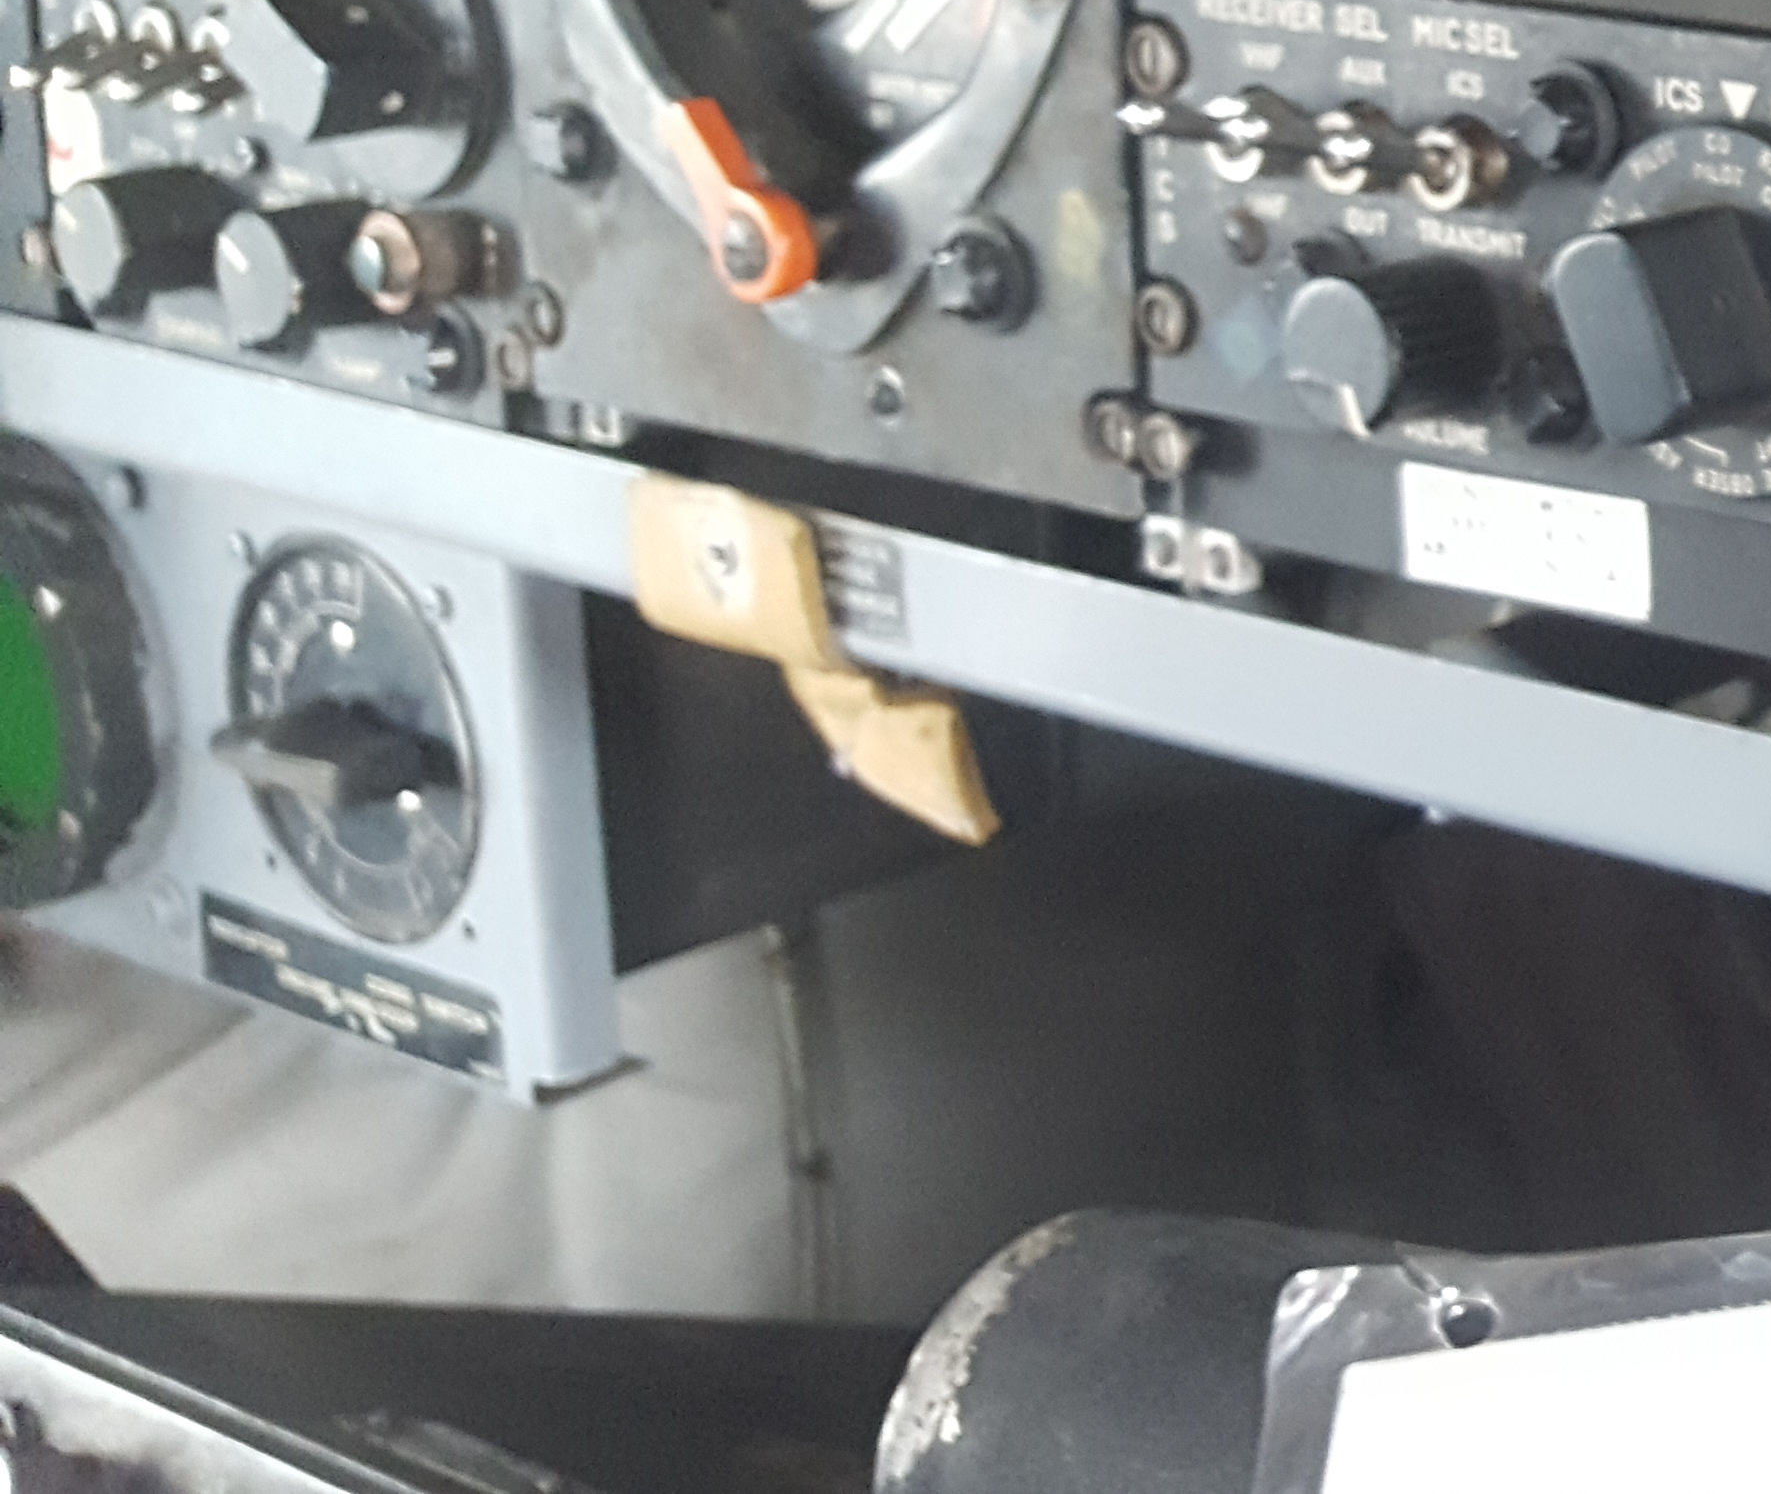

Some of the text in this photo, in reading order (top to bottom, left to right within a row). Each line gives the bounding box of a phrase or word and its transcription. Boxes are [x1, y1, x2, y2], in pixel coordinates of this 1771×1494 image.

[1334, 2, 1390, 44] SEL
[1655, 76, 1705, 113] ICS
[1415, 215, 1528, 258] TRANSMIT
